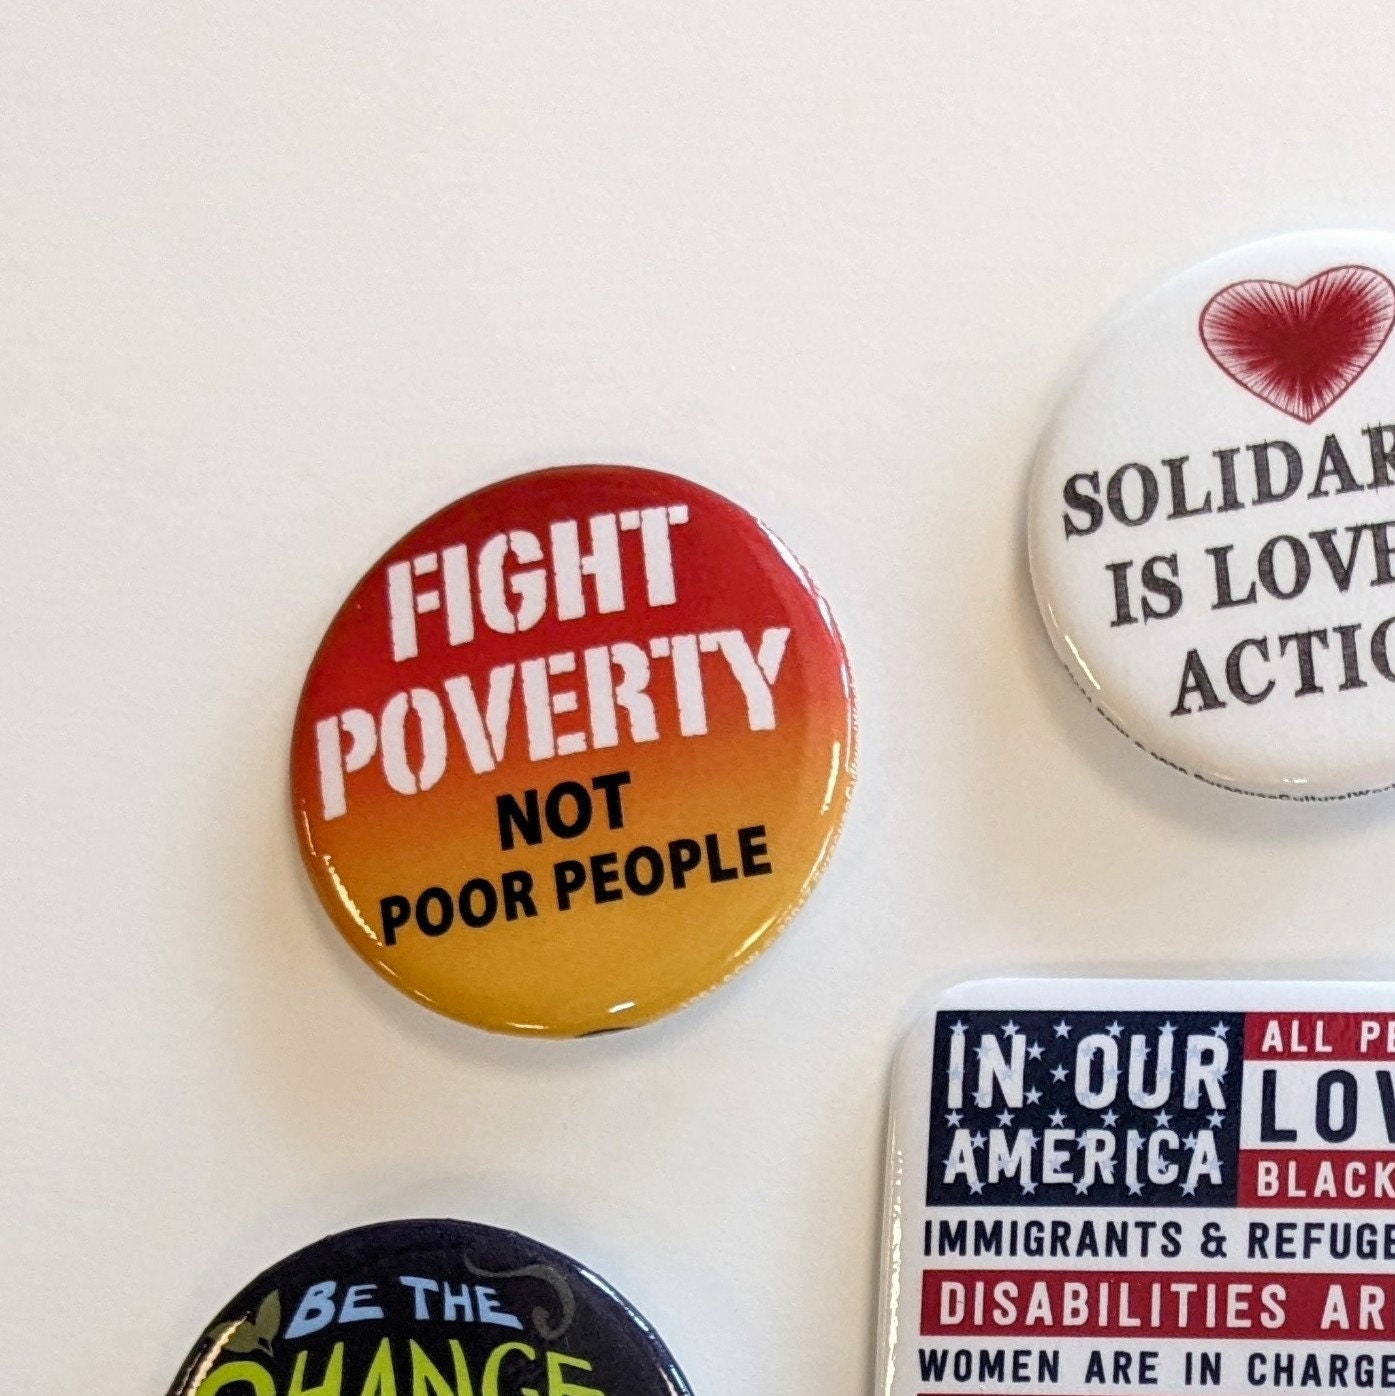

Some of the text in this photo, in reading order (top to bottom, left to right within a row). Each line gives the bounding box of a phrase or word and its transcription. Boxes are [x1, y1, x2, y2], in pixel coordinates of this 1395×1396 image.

[387, 504, 689, 663] FIGHT
[1105, 552, 1184, 627] IS
[316, 627, 790, 821] POVERTY
[496, 771, 631, 851] NOT
[380, 825, 772, 946] POOR PEOPLE
[1261, 1020, 1333, 1053] ALL
[946, 1034, 1229, 1110] IN OUR
[942, 1128, 1223, 1186] AMERICA
[923, 1219, 1182, 1258] IMMIGRANTS
[1200, 1222, 1227, 1258] &
[284, 1275, 523, 1340] BE THE
[939, 1280, 1287, 1329] DISABILITIES
[918, 1347, 1060, 1384] WOMEN
[1084, 1350, 1159, 1385] ARE
[1184, 1352, 1222, 1386] IN
